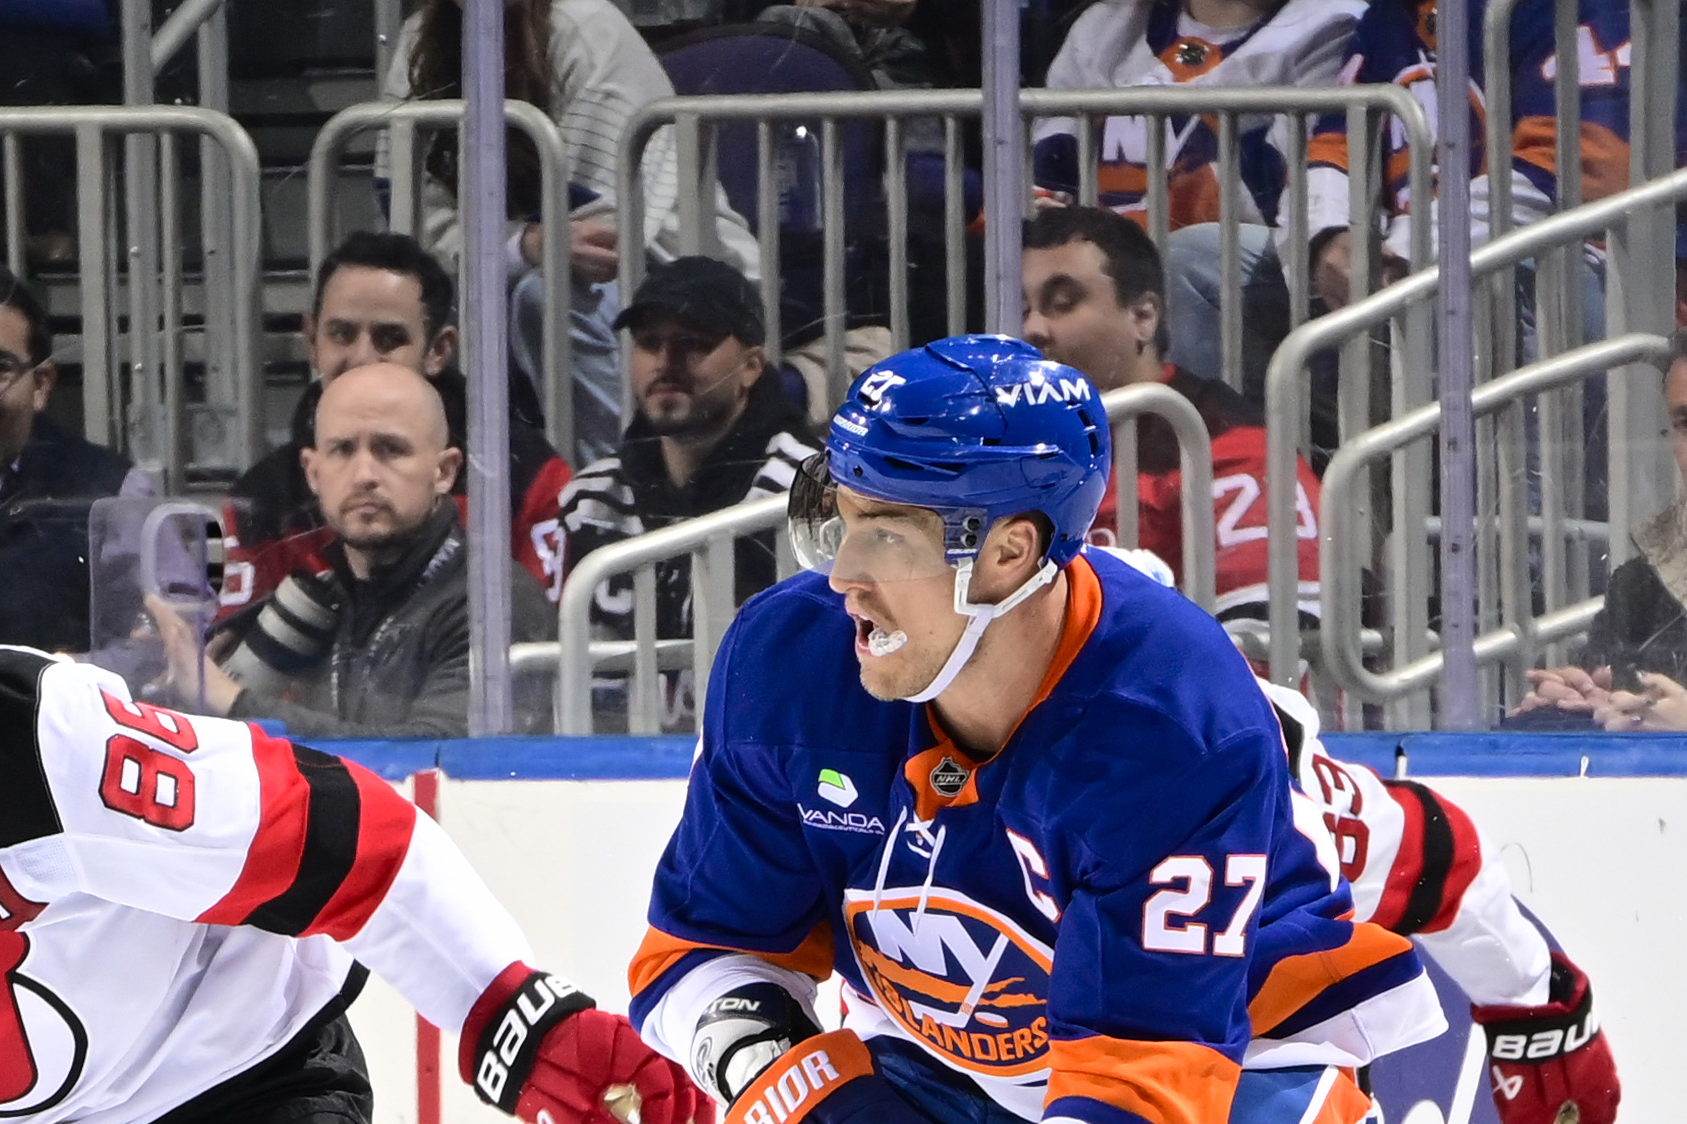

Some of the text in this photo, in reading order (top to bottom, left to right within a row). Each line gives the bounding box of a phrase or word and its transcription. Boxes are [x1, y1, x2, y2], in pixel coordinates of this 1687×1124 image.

[995, 377, 1092, 409] VIAM
[98, 686, 199, 833] 86
[797, 802, 886, 832] VANDA
[1005, 828, 1062, 923] C
[1141, 853, 1268, 957] 27
[866, 908, 1011, 1002] NY
[1491, 1011, 1594, 1060] BAU
